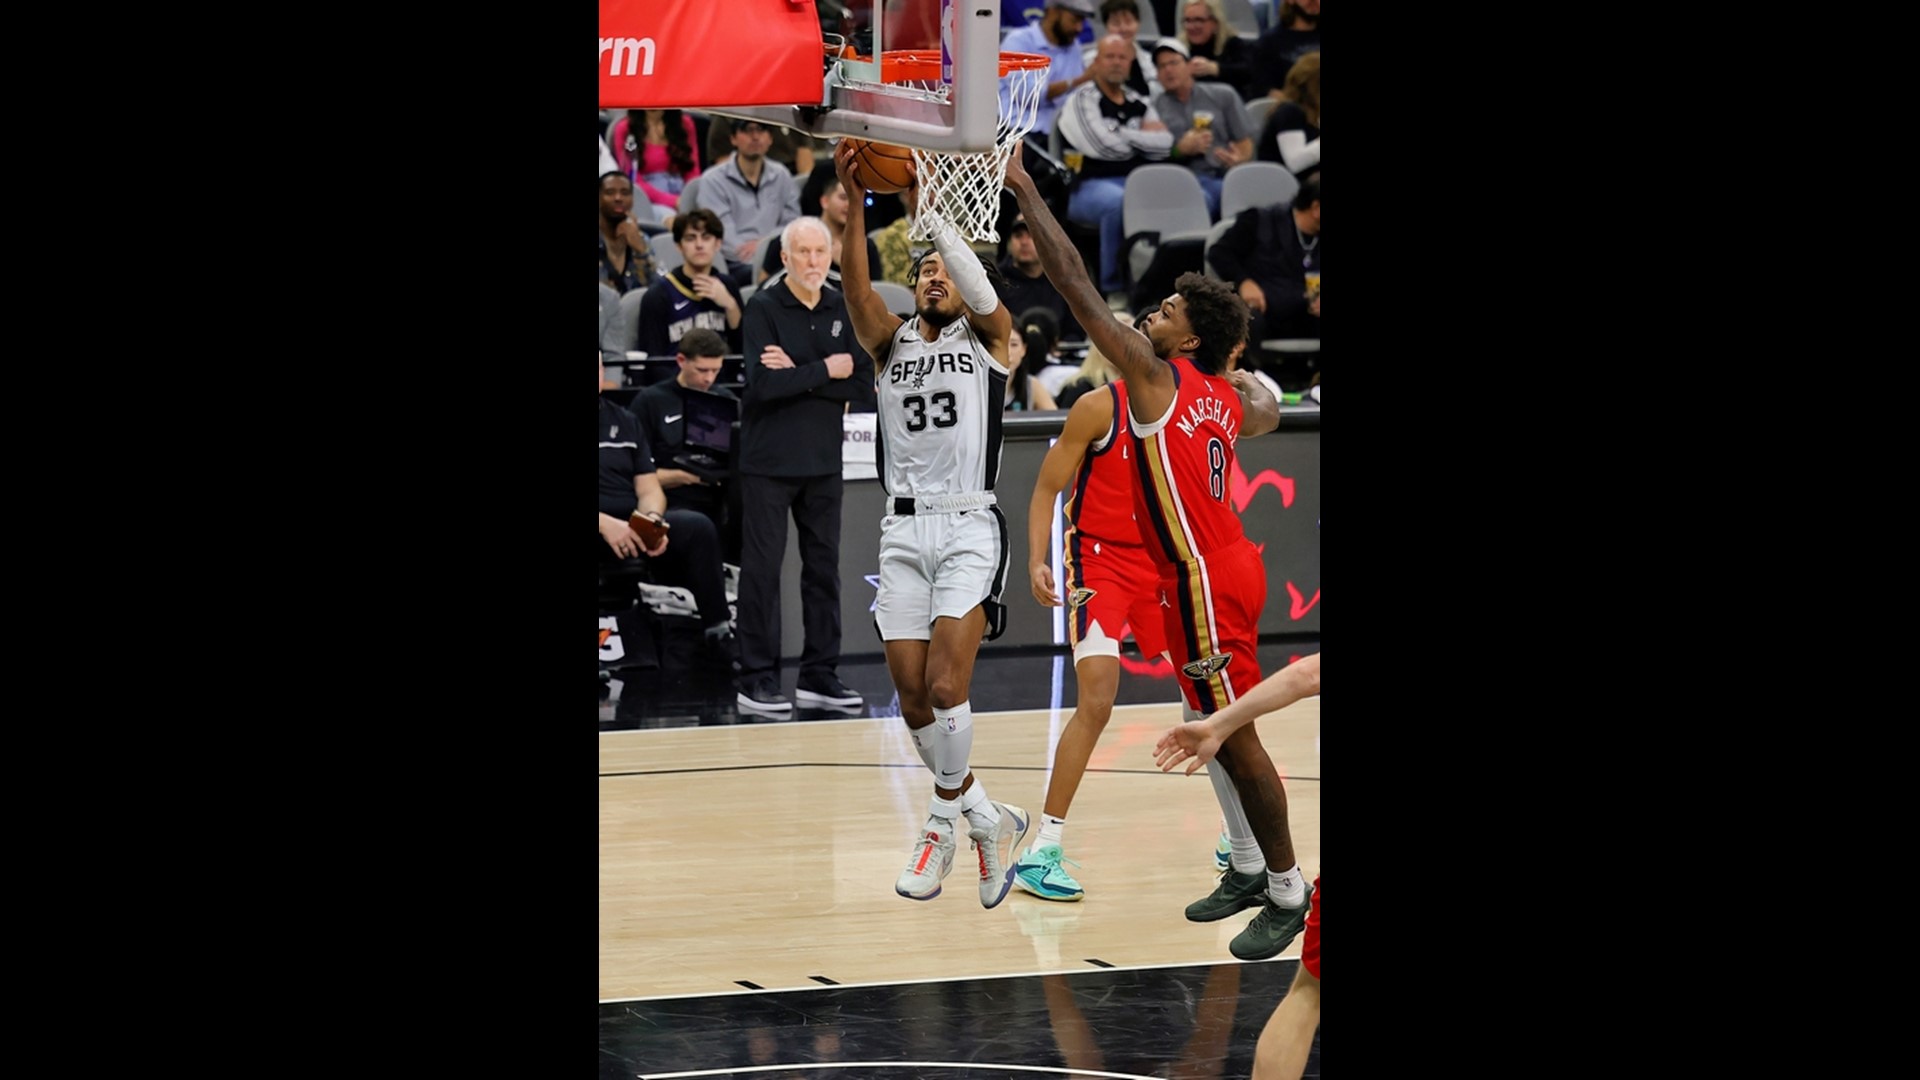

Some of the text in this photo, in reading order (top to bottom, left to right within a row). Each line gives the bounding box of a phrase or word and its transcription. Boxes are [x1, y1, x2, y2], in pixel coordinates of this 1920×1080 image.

[891, 353, 974, 389] SPURS
[903, 391, 958, 432] 33
[843, 430, 876, 442] TOR
[1207, 437, 1227, 503] 8
